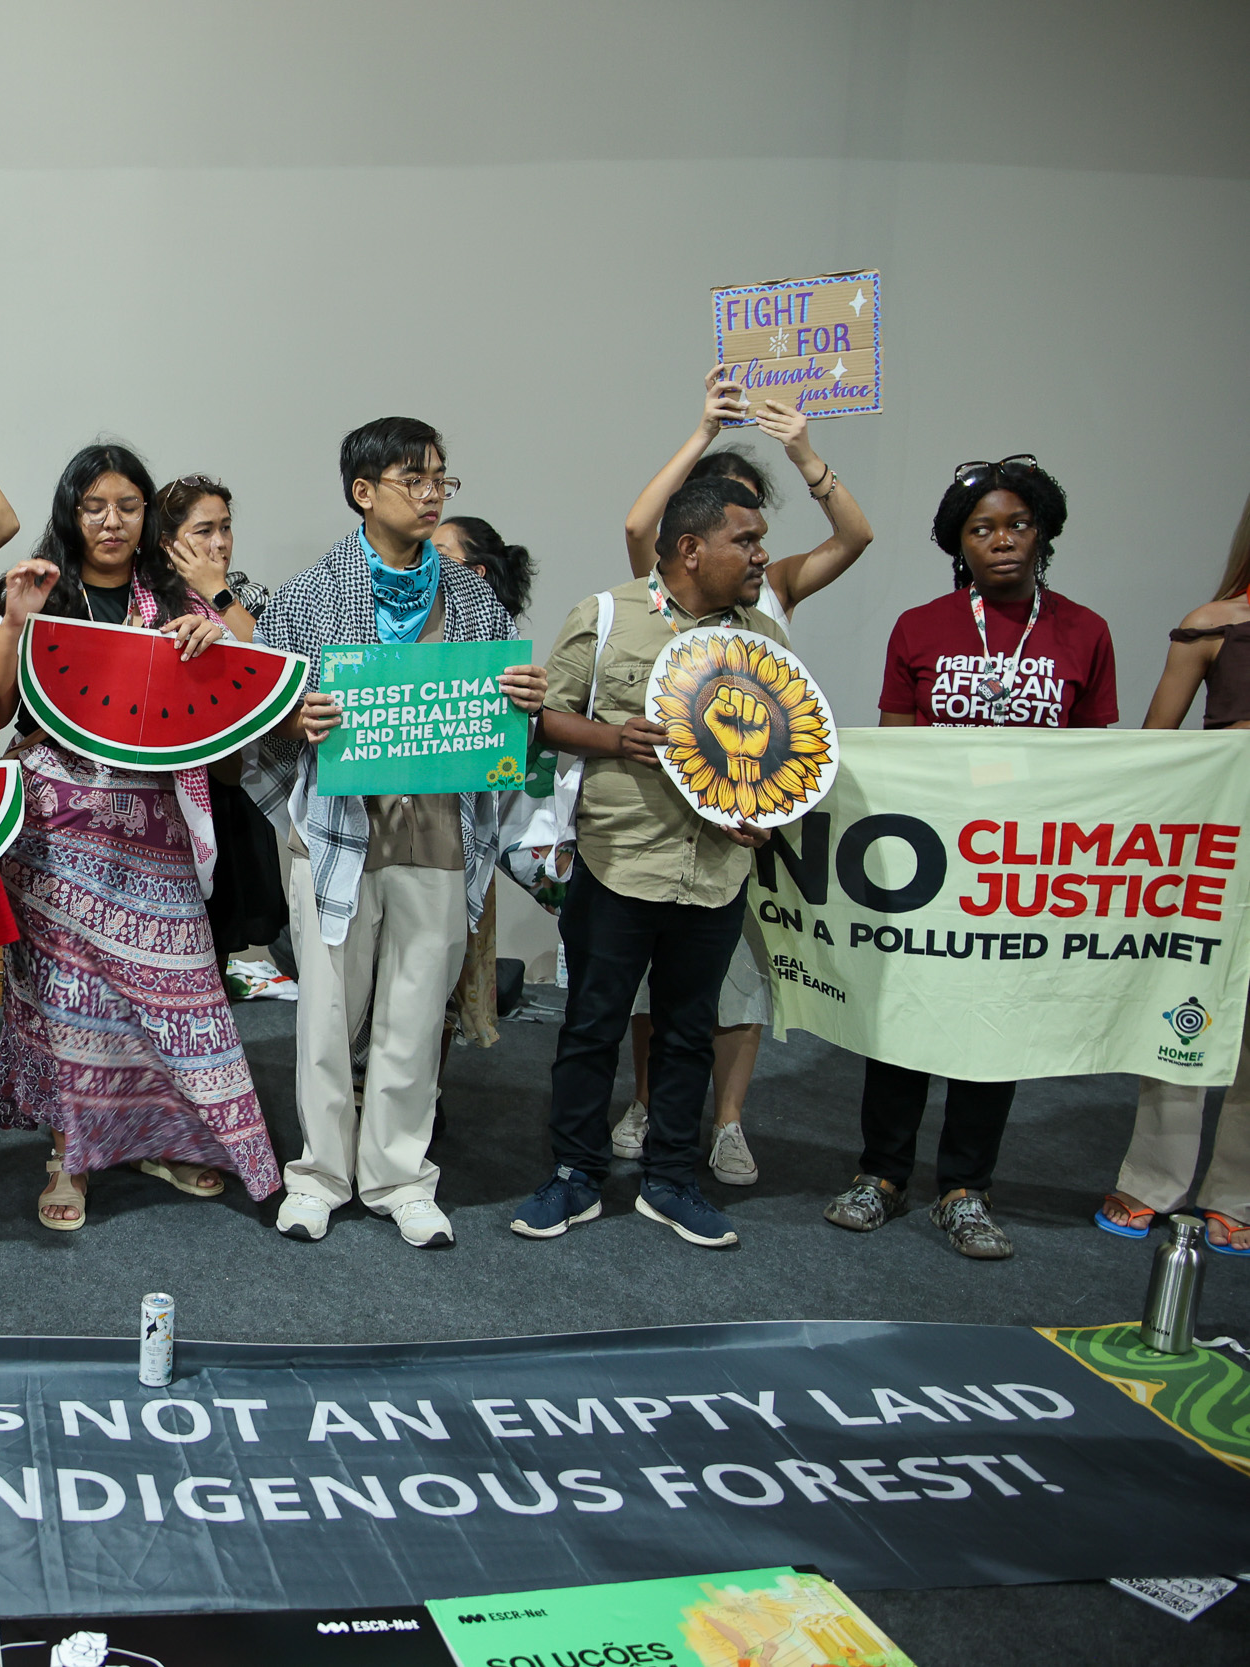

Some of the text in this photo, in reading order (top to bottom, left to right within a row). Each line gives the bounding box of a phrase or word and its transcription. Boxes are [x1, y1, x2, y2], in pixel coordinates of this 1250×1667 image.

[727, 292, 814, 331] FIGHT
[797, 323, 851, 356] FOR
[729, 357, 830, 391] Climate
[795, 380, 873, 412] justice
[330, 684, 414, 708] RESIST
[340, 697, 508, 729] IMPERIALISM!
[340, 733, 505, 762] AND MILITARISM!
[356, 719, 492, 745] END THE WARS
[957, 819, 1241, 870] CLIMATE
[754, 811, 947, 913] NO
[958, 872, 1227, 922] JUSTICE
[759, 899, 1222, 965] ON A POLLUTED PLANET
[777, 967, 846, 1004] HE EARTH
[1158, 1045, 1205, 1062] HOMEF
[59, 1398, 268, 1444] NOT
[307, 1399, 451, 1442] AN
[472, 1390, 787, 1438] EMPTY
[807, 1383, 1076, 1427] LAND
[639, 1454, 1065, 1509] FOREST!
[351, 1618, 420, 1633] ESCR-Net
[489, 1608, 548, 1622] ESCR-Net
